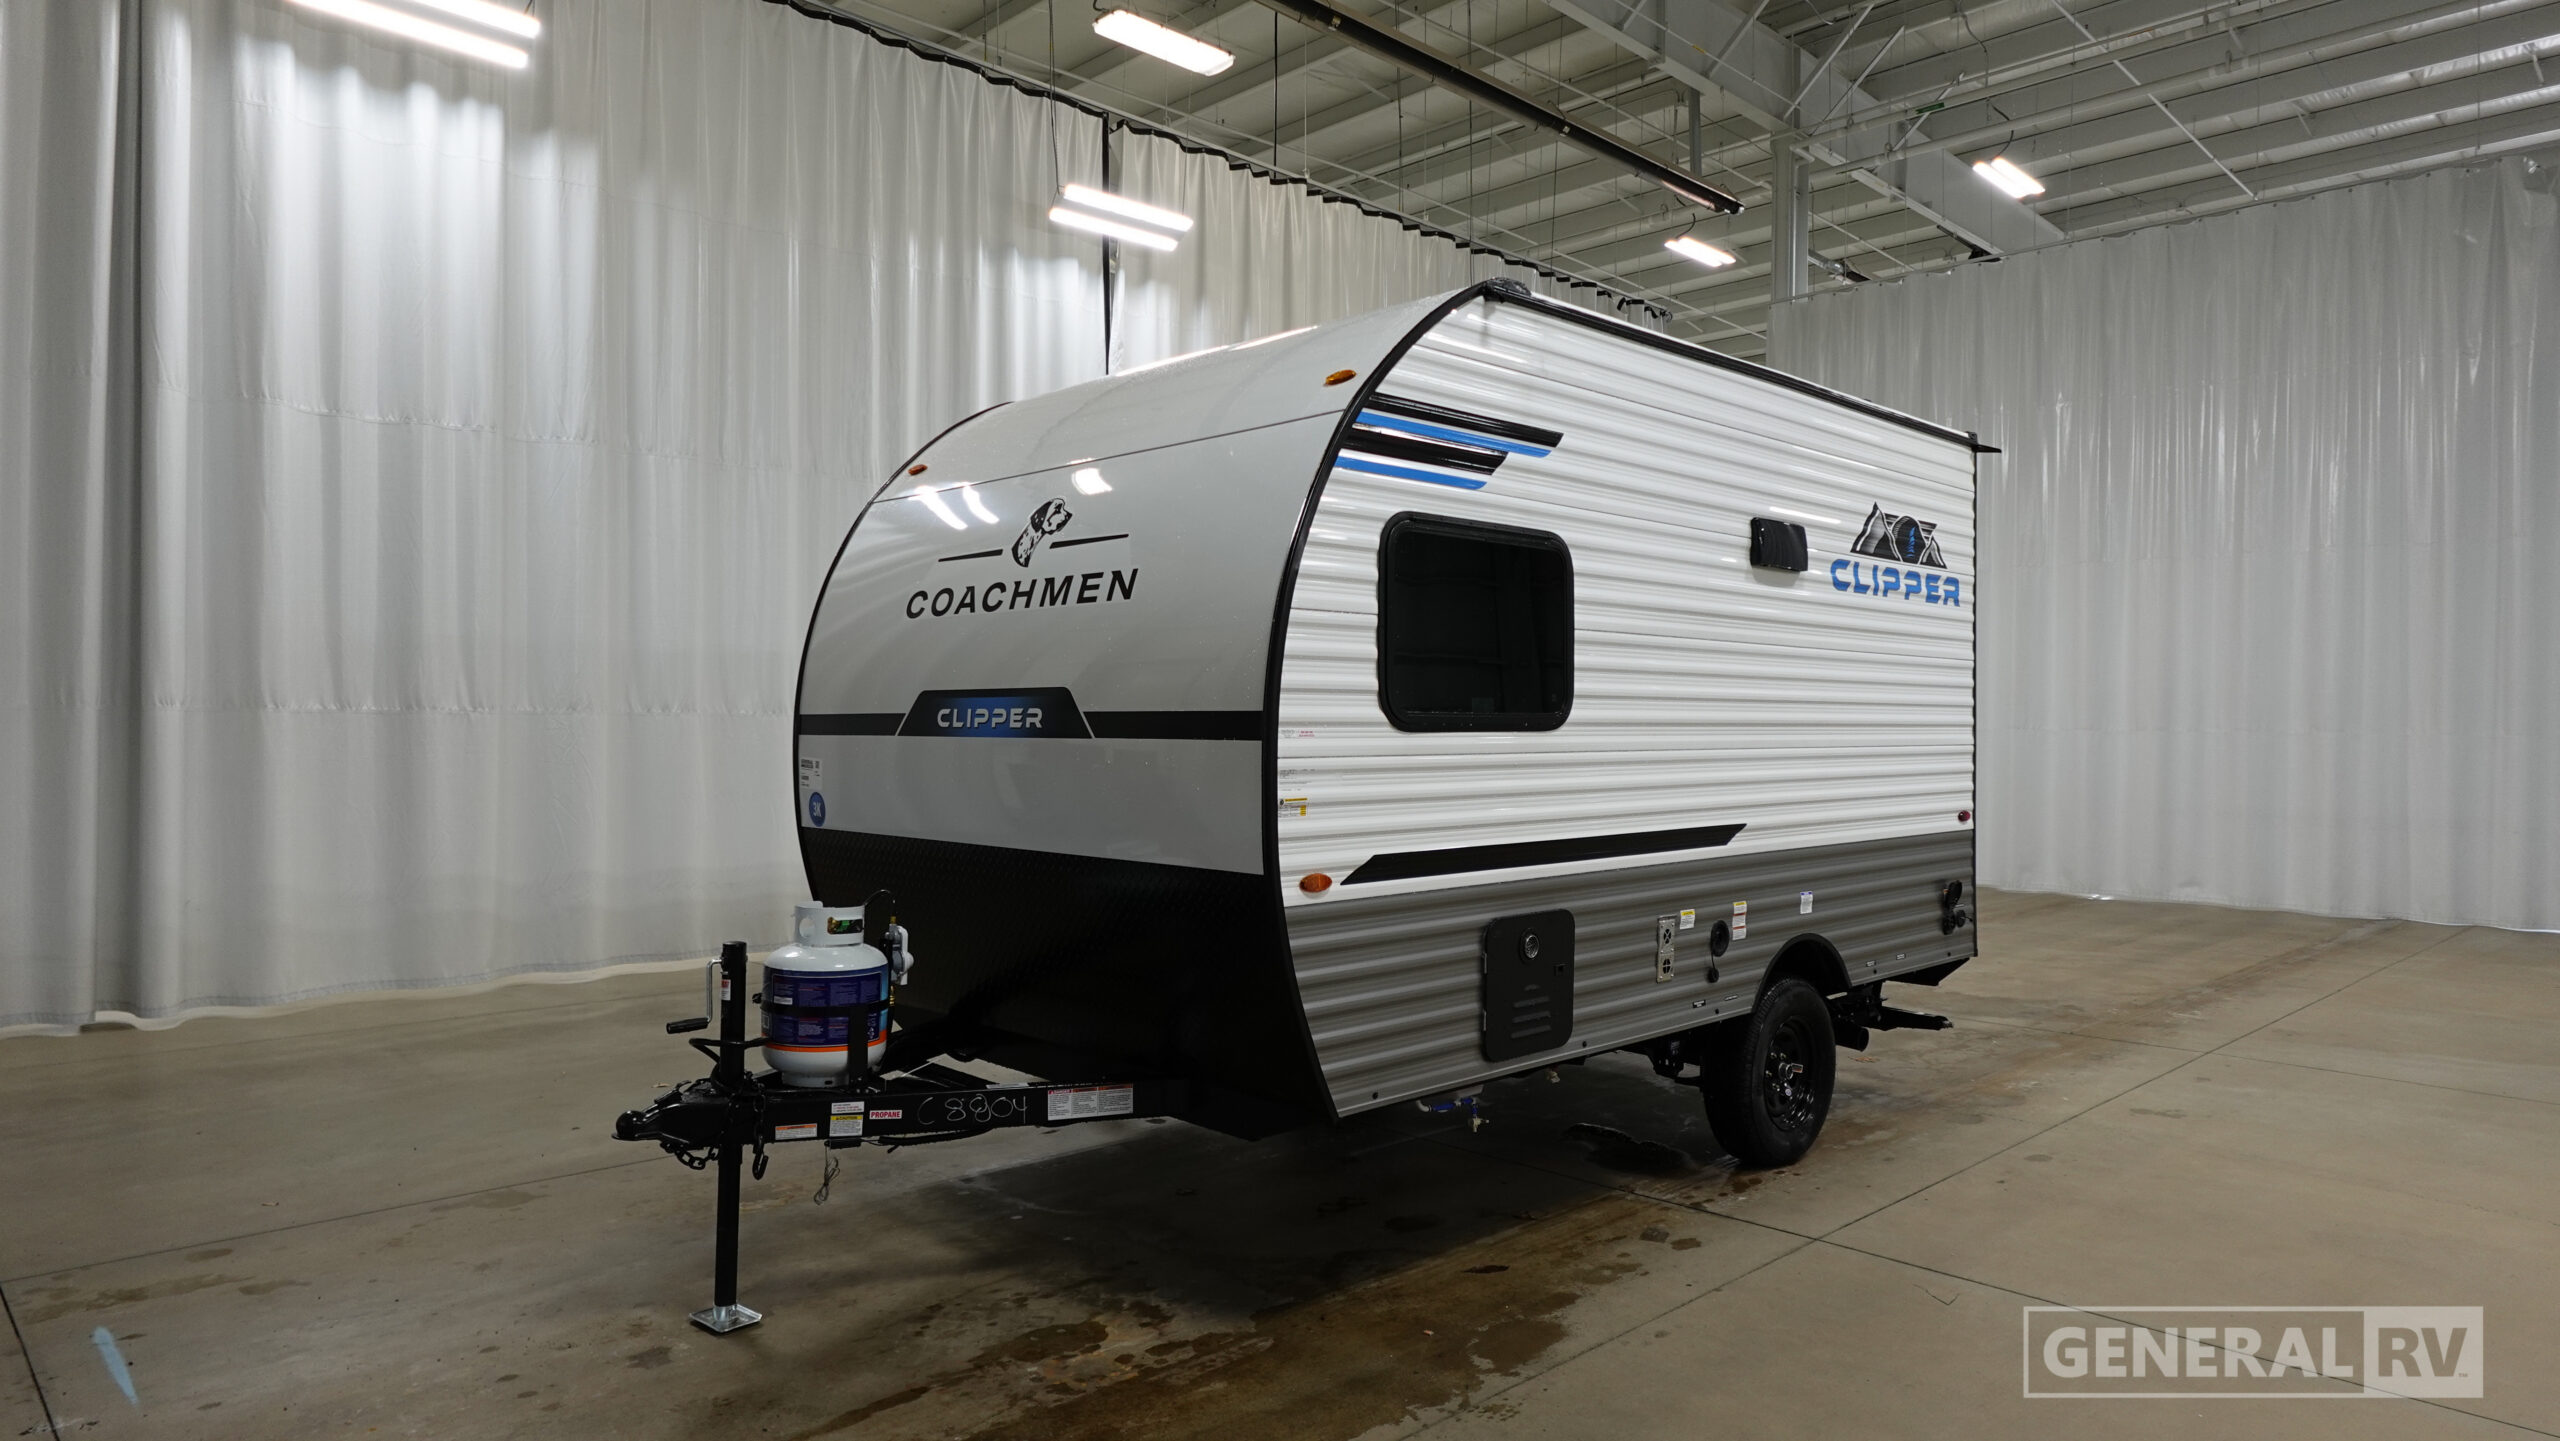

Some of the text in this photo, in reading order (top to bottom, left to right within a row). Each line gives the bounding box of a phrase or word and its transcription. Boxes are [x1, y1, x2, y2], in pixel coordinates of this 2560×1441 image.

[906, 568, 1139, 619] COACHMEN
[1830, 558, 1960, 607] CLIPPER
[937, 708, 1043, 729] CLIPPER
[870, 1111, 901, 1119] PROPANE
